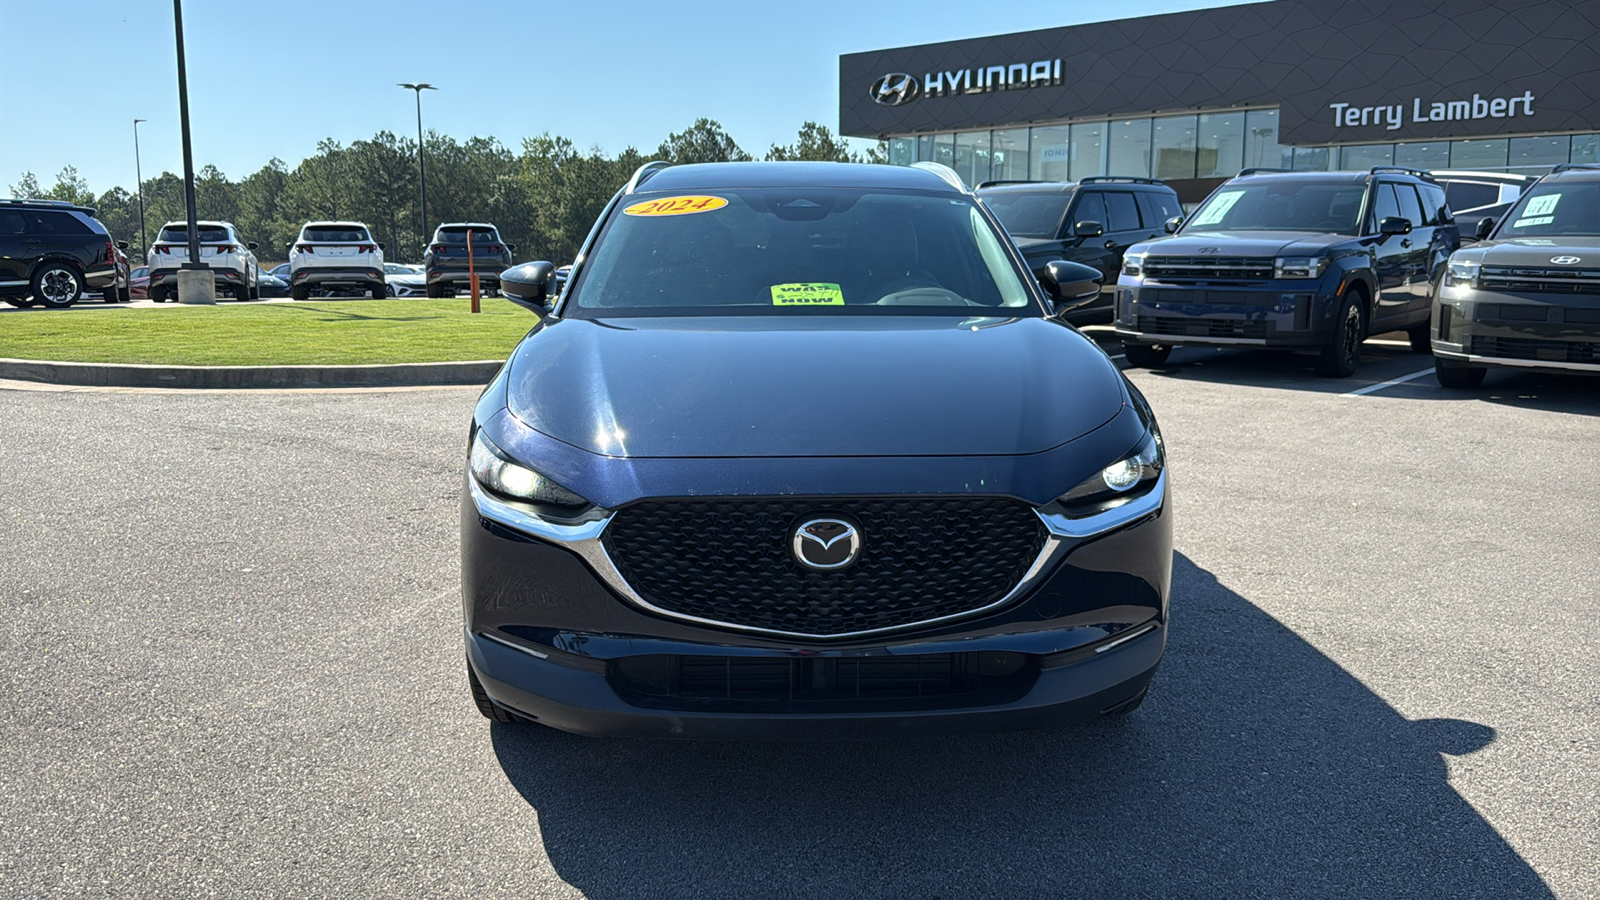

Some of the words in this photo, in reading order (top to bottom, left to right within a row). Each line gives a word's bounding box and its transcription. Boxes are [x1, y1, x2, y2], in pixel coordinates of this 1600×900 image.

[924, 59, 1064, 98] HYUNDAI
[1330, 102, 1403, 131] Terry
[1412, 90, 1536, 123] Lambert
[637, 197, 715, 215] 2024
